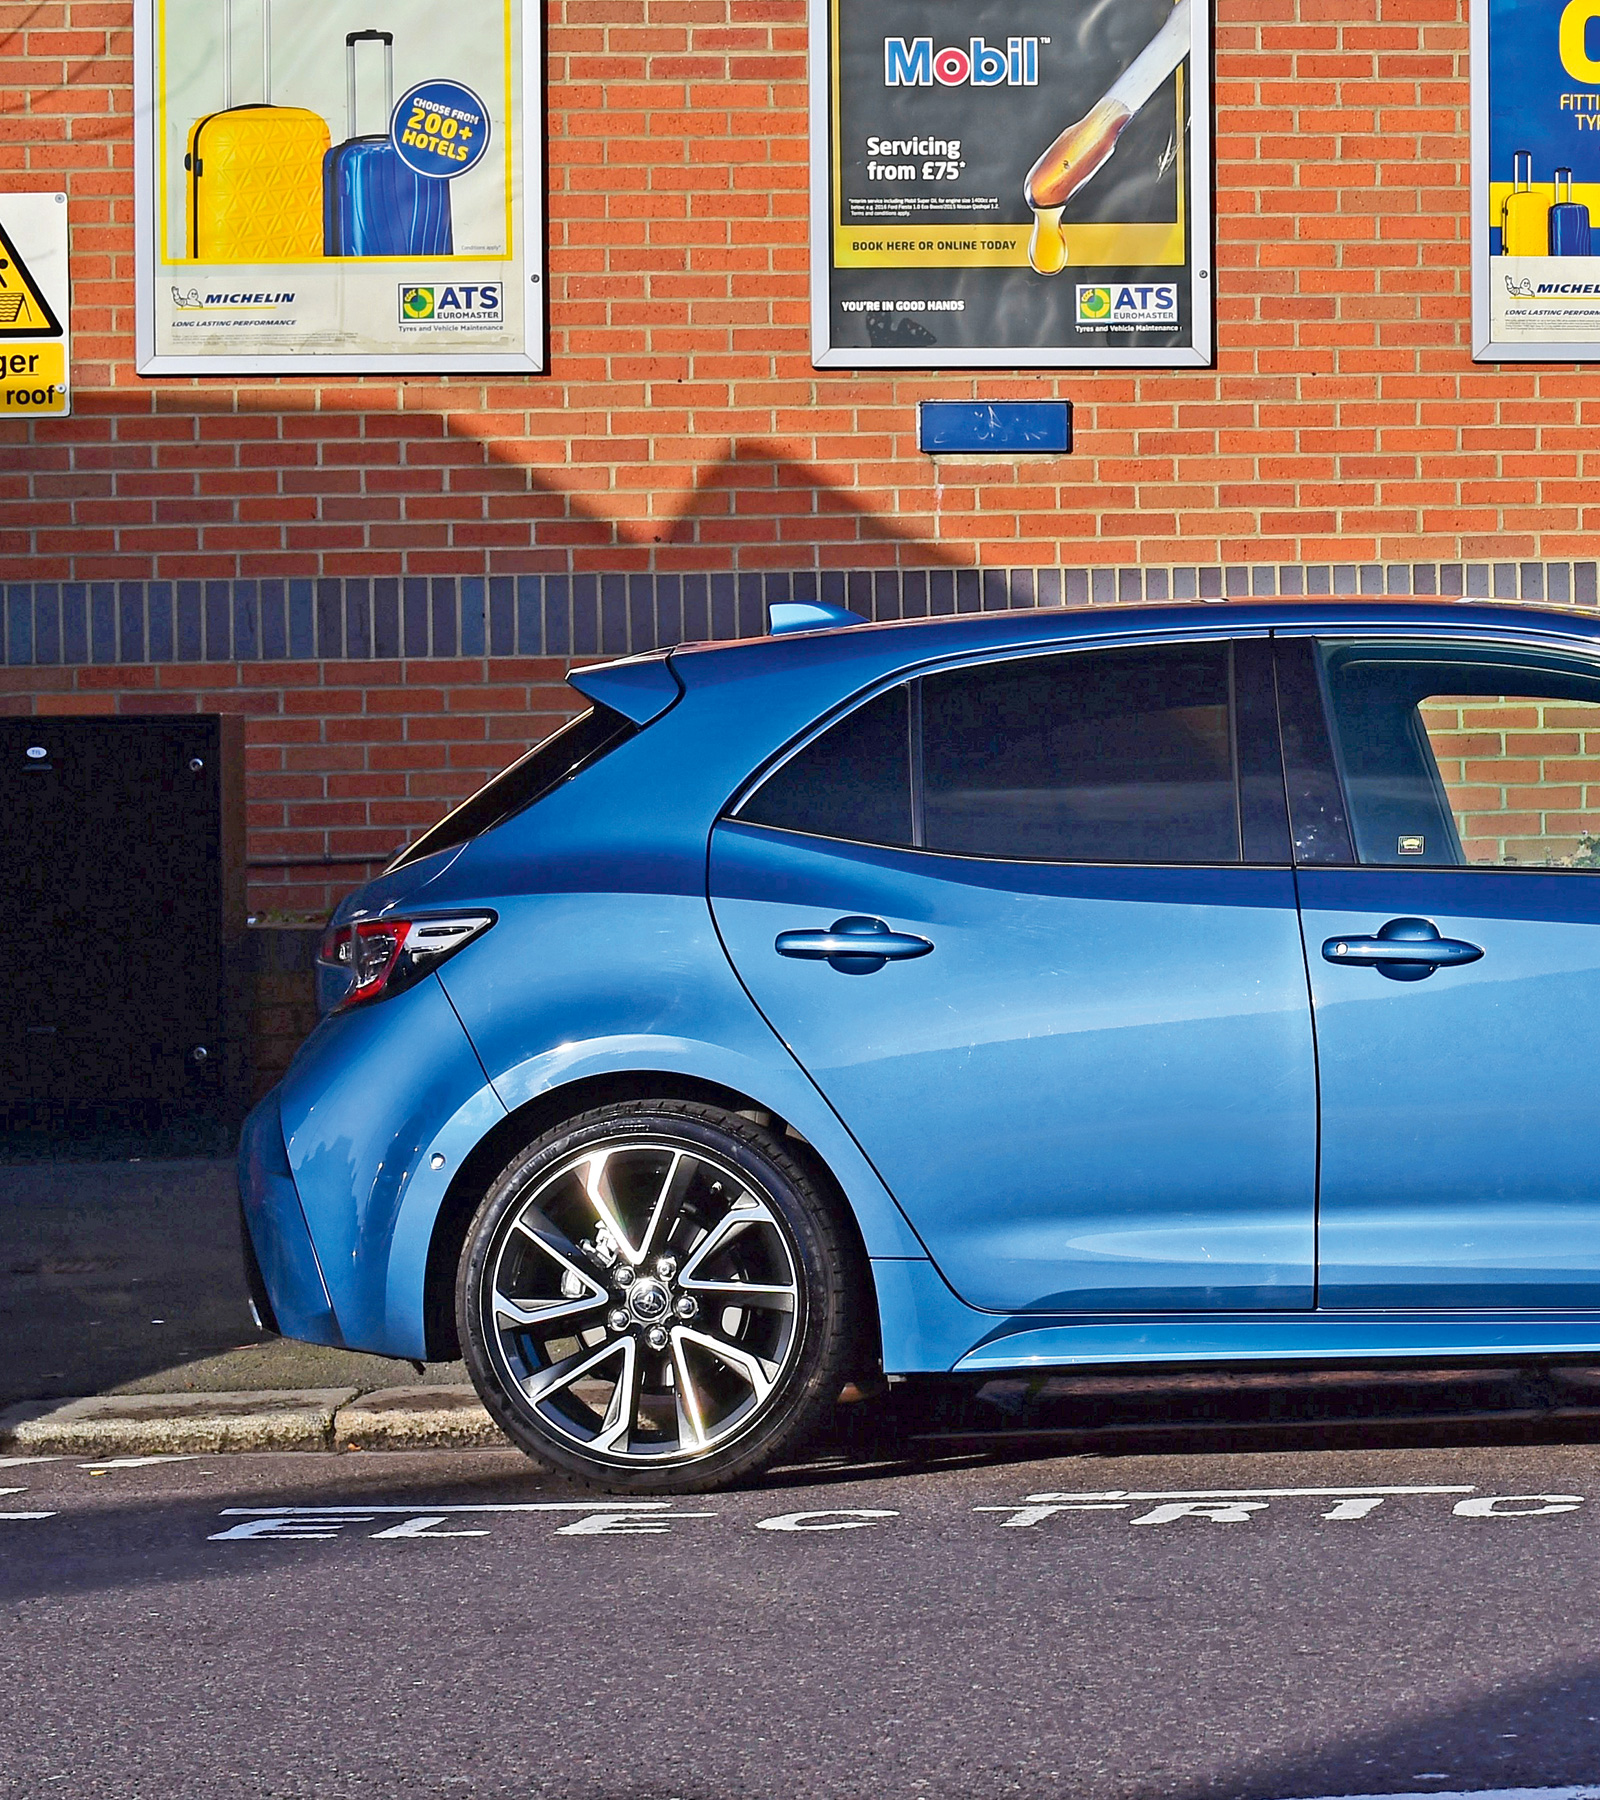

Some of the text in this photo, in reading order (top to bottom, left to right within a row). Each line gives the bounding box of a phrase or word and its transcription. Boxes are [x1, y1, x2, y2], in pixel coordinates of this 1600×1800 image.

[884, 37, 1039, 86] Mobil
[413, 97, 479, 125] CHOOSE FROM
[407, 107, 473, 140] 200+
[401, 129, 469, 161] HOTELS
[867, 136, 961, 160] Servicing
[867, 161, 916, 180] from
[853, 241, 1016, 250] BOOK HERE OR ONLINE TODAY
[205, 293, 295, 303] MICHELIN
[438, 286, 499, 309] ATS
[841, 301, 965, 311] YOU'RE IN GOOD HANDS
[1114, 287, 1174, 310] ATS
[1075, 325, 1094, 333] Tyres
[6, 385, 54, 405] roof
[207, 1494, 1585, 1540] ELECTRIC
